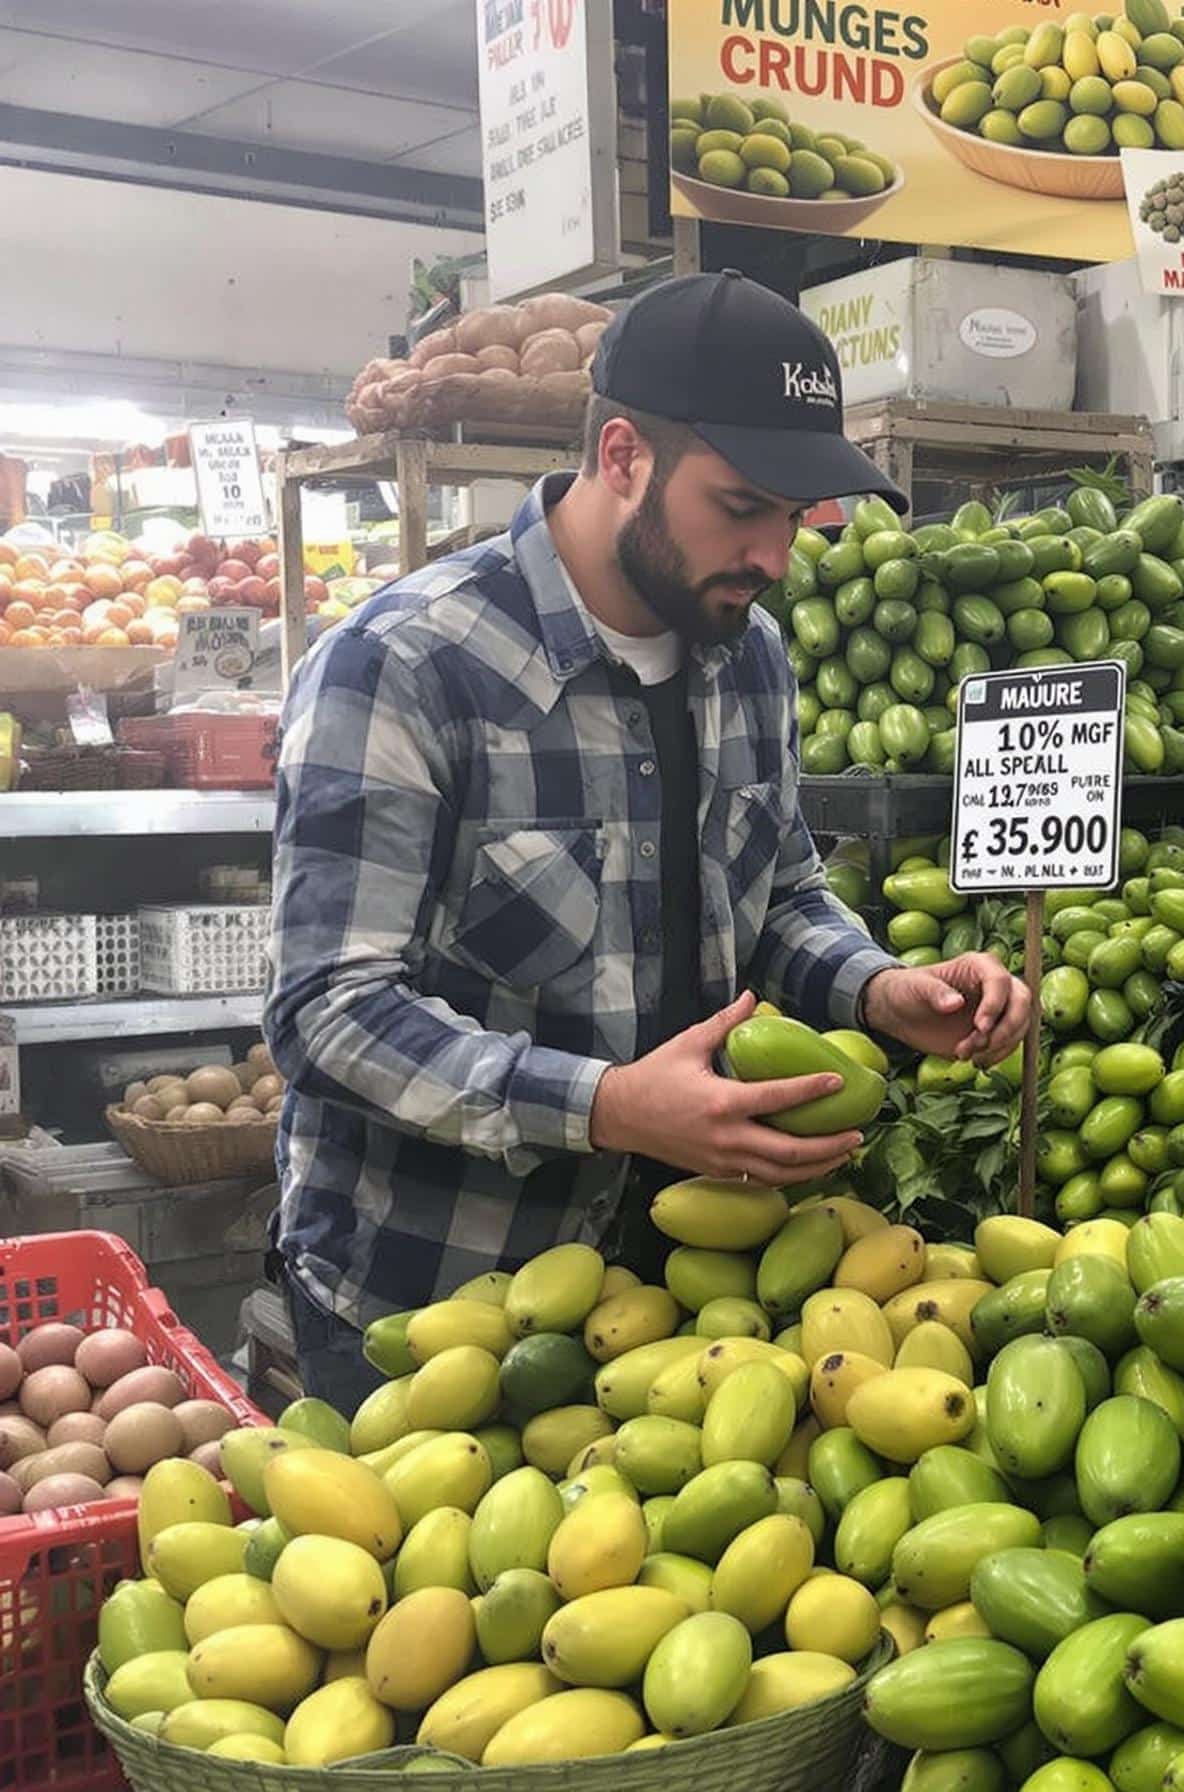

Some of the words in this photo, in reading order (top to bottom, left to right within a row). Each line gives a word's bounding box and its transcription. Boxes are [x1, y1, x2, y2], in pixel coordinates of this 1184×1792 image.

[720, 35, 906, 108] CRUND
[998, 719, 1064, 752] 10%
[1071, 722, 1115, 745] MGF
[964, 758, 995, 778] ALL
